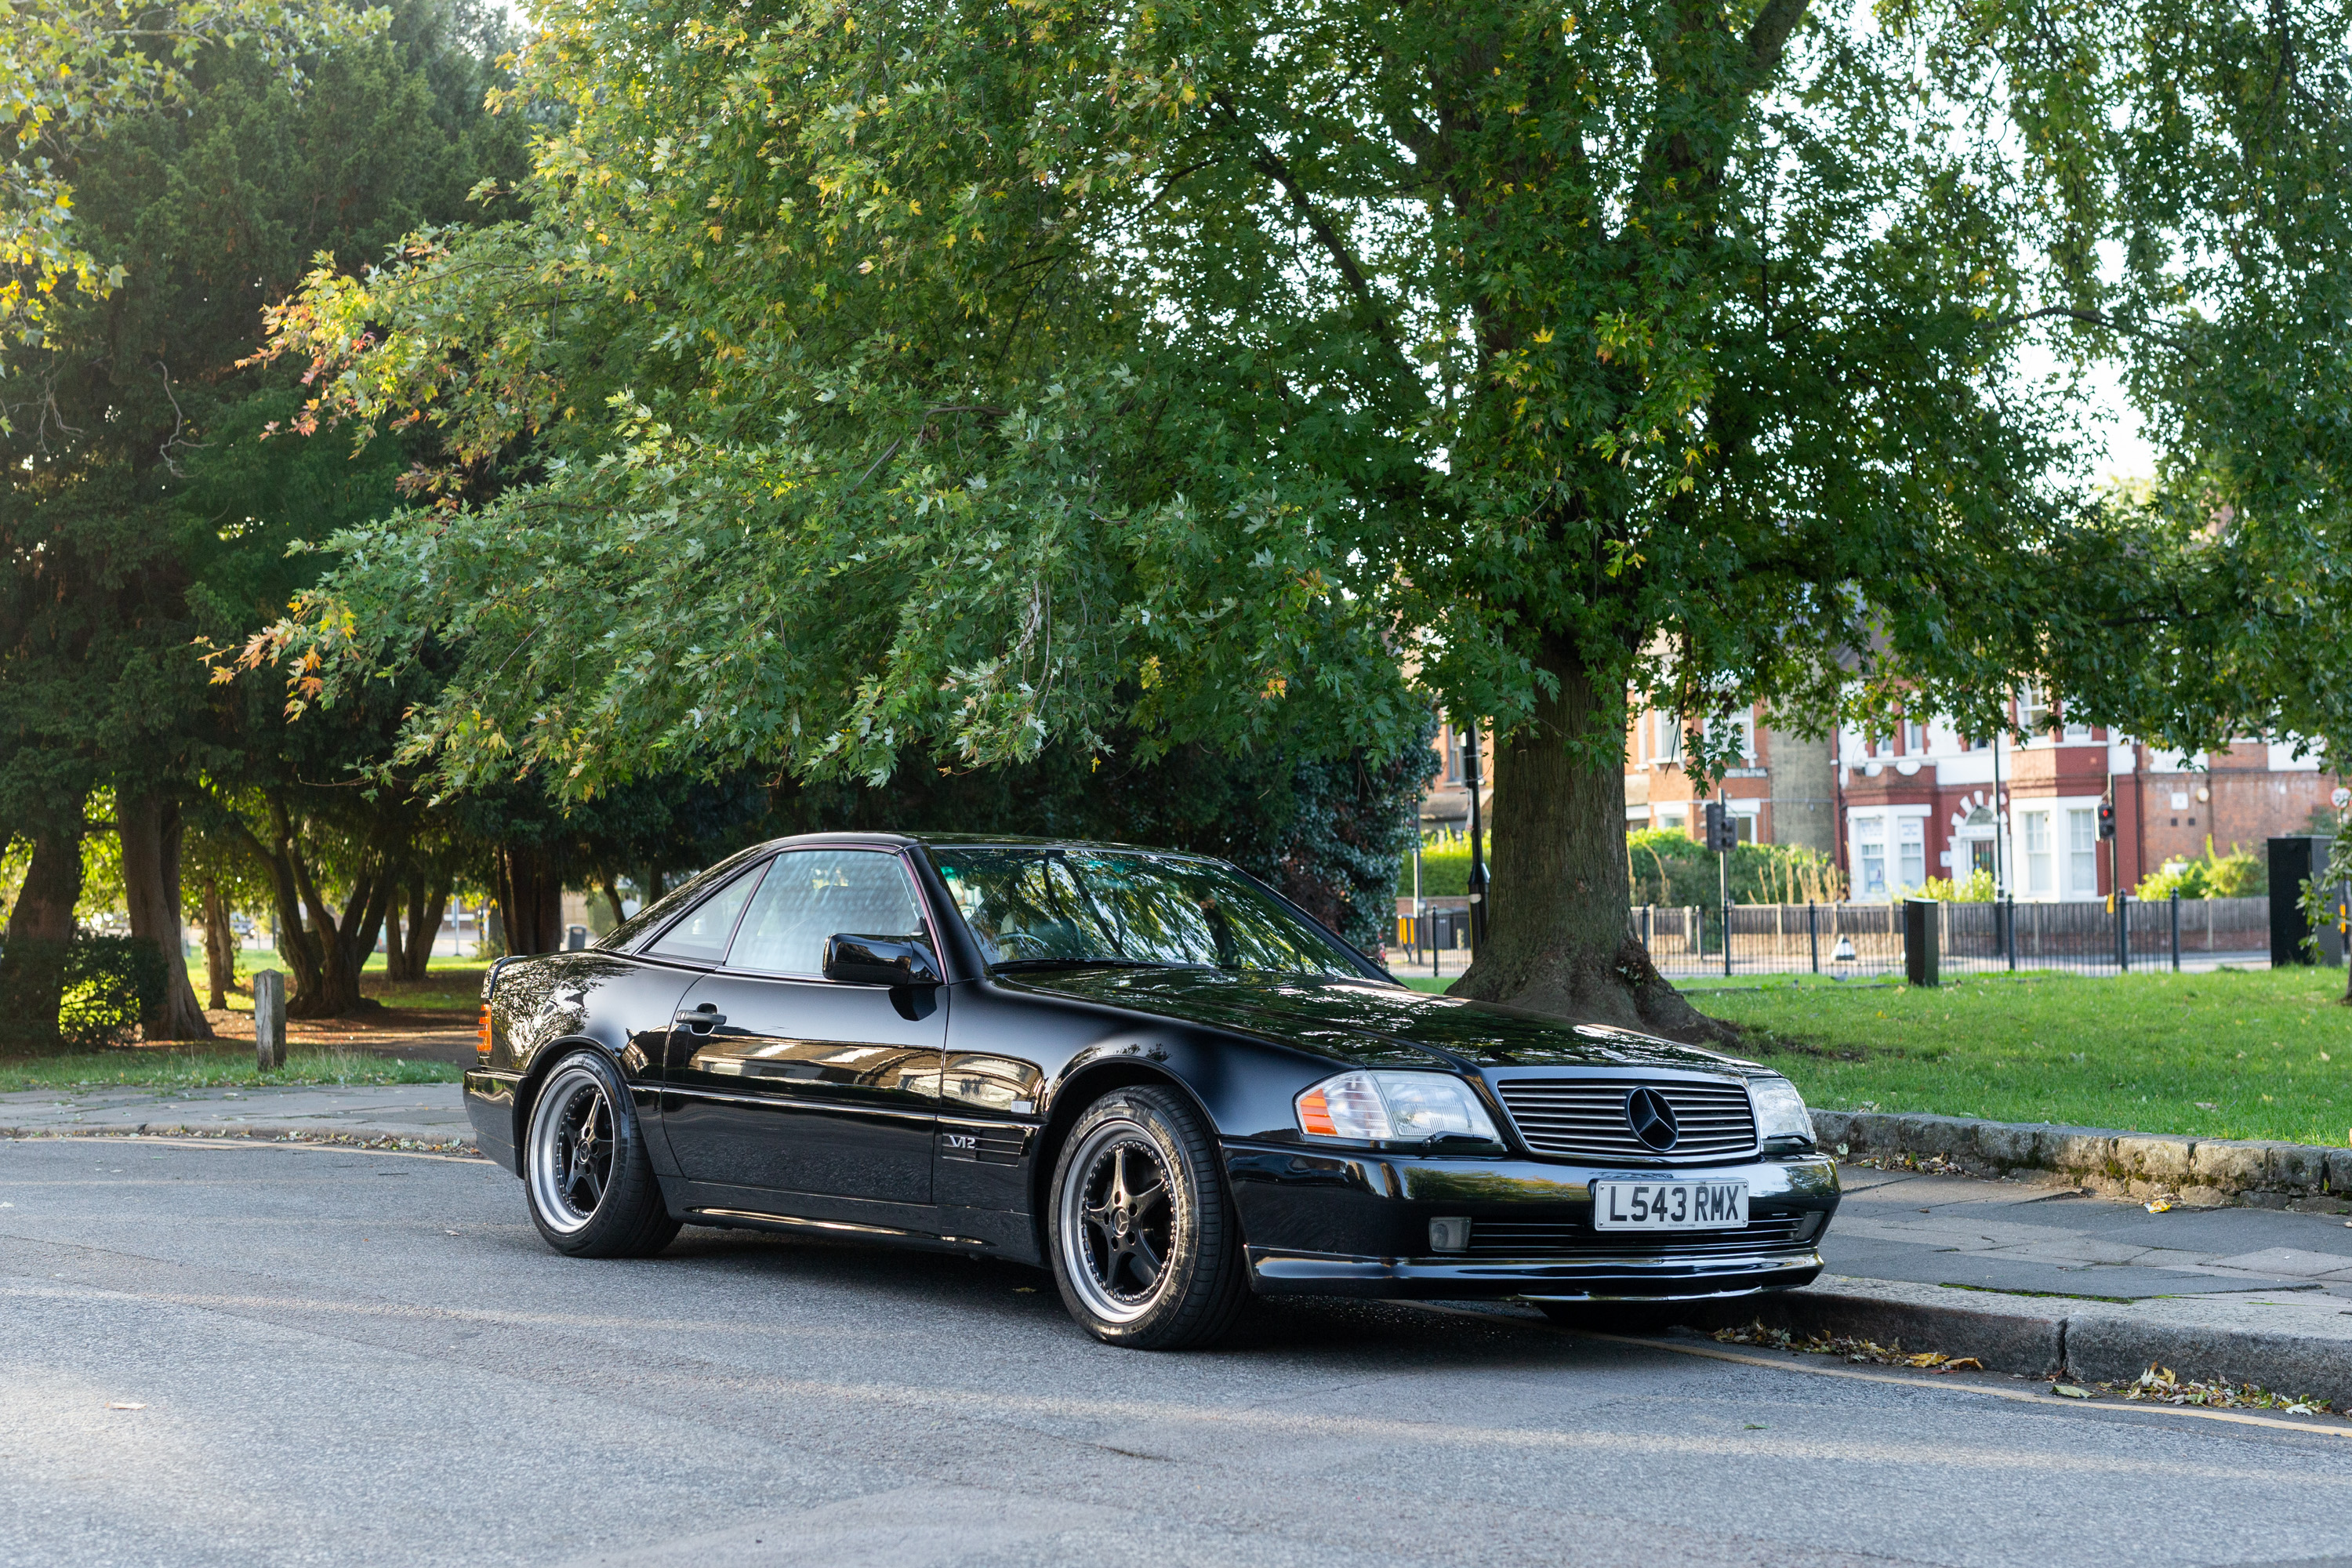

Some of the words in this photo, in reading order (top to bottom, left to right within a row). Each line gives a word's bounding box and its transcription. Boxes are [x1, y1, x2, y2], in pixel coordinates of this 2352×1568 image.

[949, 1135, 976, 1149] V12
[1610, 1185, 1687, 1222] L543
[1694, 1185, 1739, 1221] RMX
